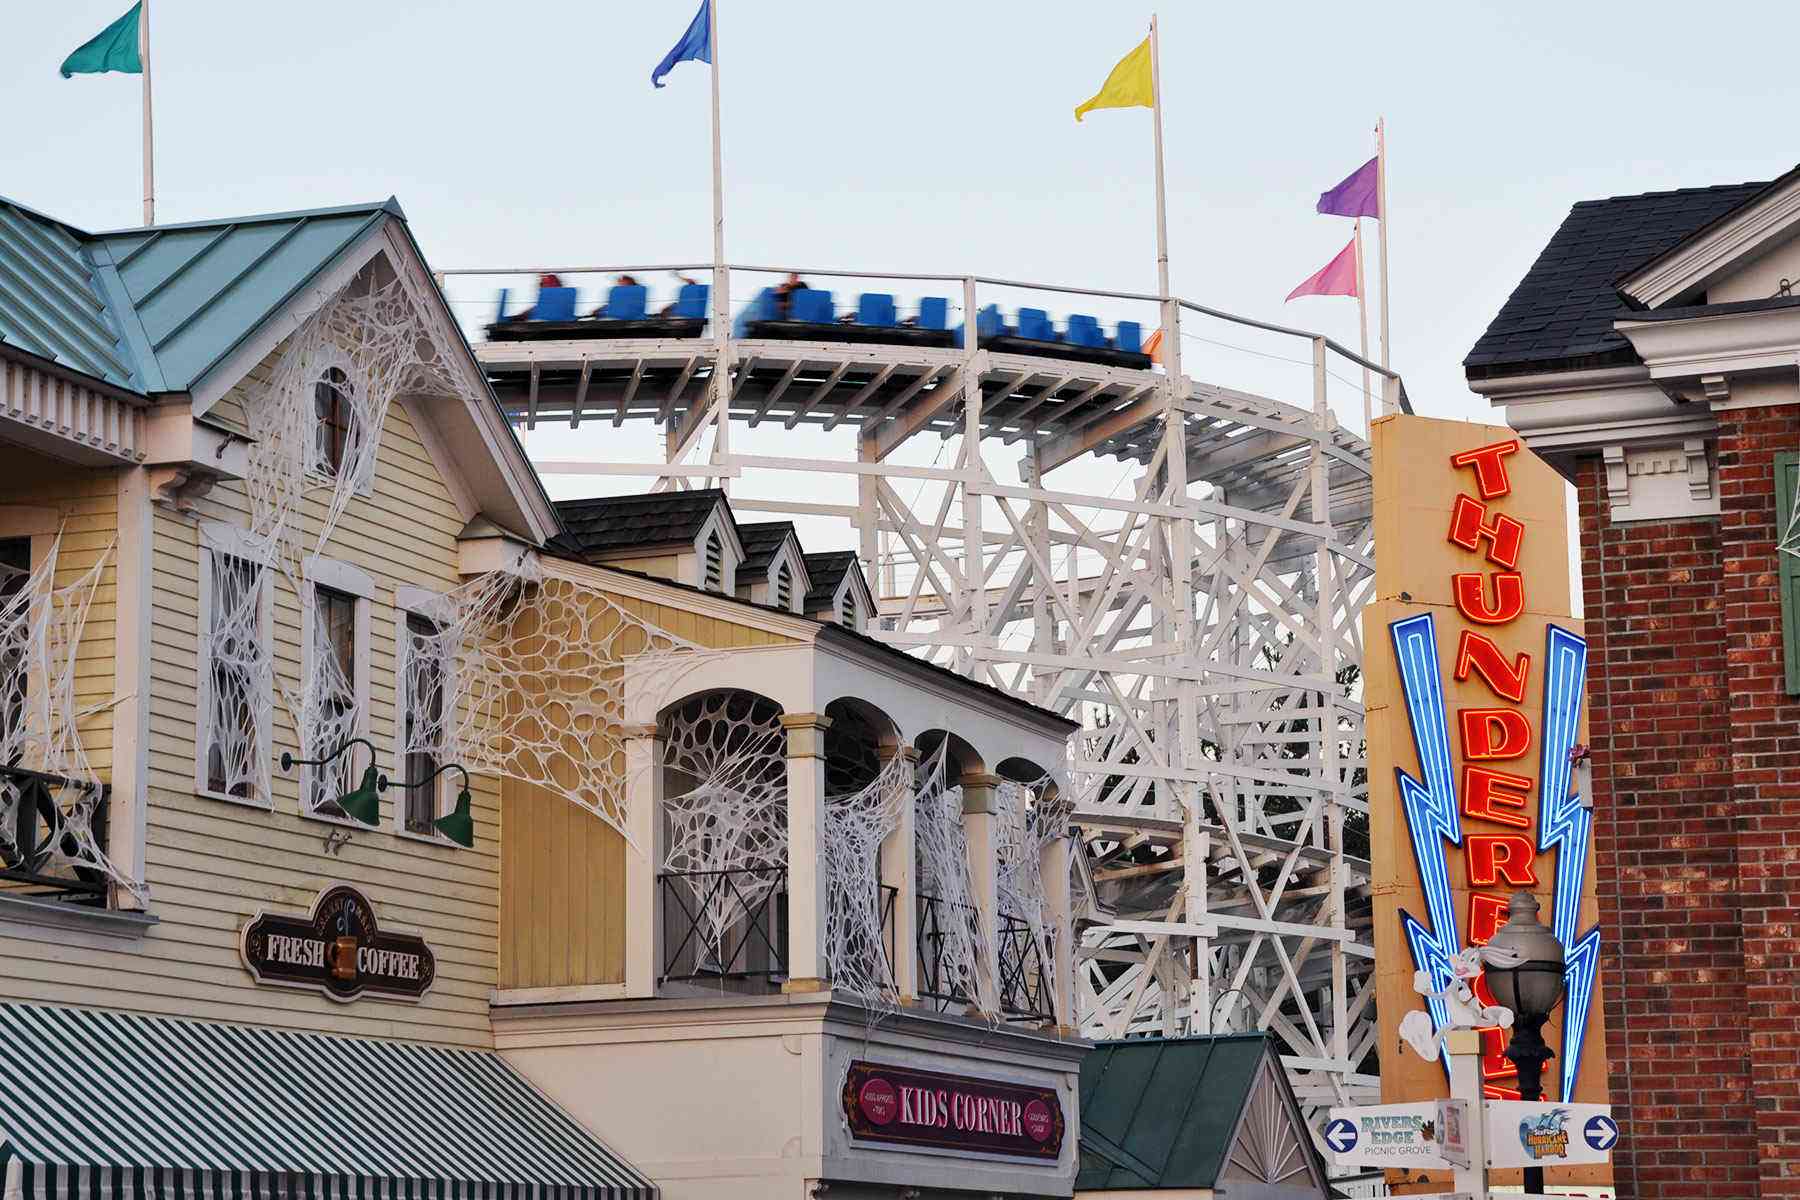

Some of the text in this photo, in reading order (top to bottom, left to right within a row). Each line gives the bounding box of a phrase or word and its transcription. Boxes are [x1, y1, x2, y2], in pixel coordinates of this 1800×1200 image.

[267, 934, 420, 980] FRESH COFFEE
[900, 1086, 1023, 1137] KIDS CORNER
[1364, 1145, 1432, 1156] PICNIC GROVE
[1372, 1131, 1414, 1144] EDGE
